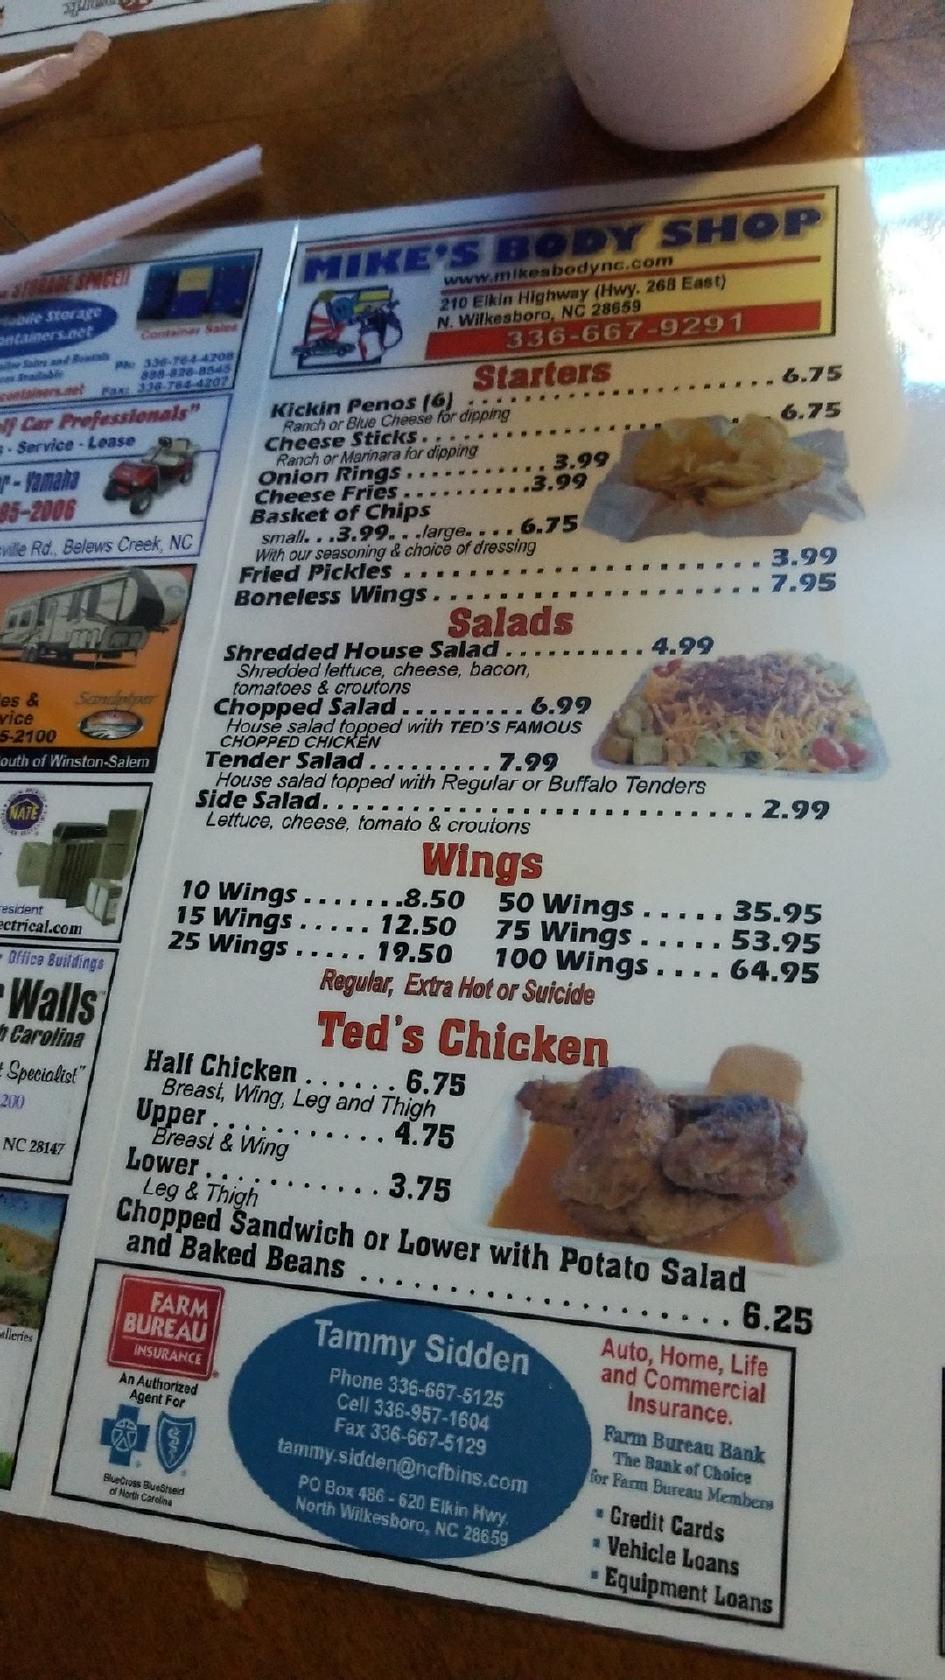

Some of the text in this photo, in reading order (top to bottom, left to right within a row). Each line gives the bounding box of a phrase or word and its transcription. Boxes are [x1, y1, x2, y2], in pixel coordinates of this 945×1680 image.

[304, 207, 822, 284] MIKE'S BODY SHOP
[443, 255, 674, 286] www.mikesbodync.com
[439, 274, 727, 312] 210 Elkin Highway (Hwy. 268 East)
[437, 300, 642, 330] N. Wilkesboro, NC 28659
[506, 312, 744, 350] 336-667-9291
[269, 364, 843, 419] Kickin Penos (6) 6.75
[472, 361, 612, 392] Starters
[20, 402, 201, 432] Car Professionals"
[264, 401, 842, 452] Cheese Sticks 6.75
[17, 435, 137, 455] Service Lease
[276, 443, 480, 467] Ranch or Marinara for dipping
[25, 468, 81, 494] Yamaha
[257, 451, 610, 487] Onion Rings 3.99
[250, 502, 432, 525] Basket of Chips
[261, 514, 579, 545] small 3.99 large 6.75
[63, 539, 115, 555] Belews
[117, 535, 164, 553] Creek,
[169, 533, 193, 551] NC
[234, 573, 838, 608] Boneless Wings 7.95
[447, 605, 575, 640] Salads
[223, 636, 715, 662] Shredded House Salad 4.99
[213, 695, 593, 721] Chopped Salad 6.99
[226, 717, 584, 738] House salad topped with TED'S FAMOUS
[37, 753, 151, 770] of Winston-Salem
[205, 751, 559, 773] Tender Salad 7.99
[9, 804, 40, 823] NATE
[205, 810, 532, 835] Lettuce, cheese, tomato & croutons
[422, 841, 544, 888] Wings
[182, 879, 466, 910] 10 Wings 8.50
[498, 891, 823, 925] 50 Wings 35.95
[8, 949, 105, 973] Office Buildings
[168, 930, 454, 964] 25 Wings 19.50
[495, 946, 820, 984] 100 Wings 64.95
[8, 977, 98, 1026] Walls
[319, 967, 596, 1006] Regular, Extra Hot or Suicide
[10, 1023, 87, 1049] Carolina
[317, 1010, 609, 1068] Ted's Chicken
[7, 1060, 87, 1085] Specialist"
[143, 1048, 467, 1097] Half Chicken 6.75
[161, 1077, 437, 1123] Breast, Wing, Leg and Thigh
[3, 1137, 67, 1157] NC 28147
[125, 1146, 452, 1203] Lower 3.75
[115, 1196, 747, 1294] Chopped Sandwich or Lower with Potato Salad
[126, 1231, 814, 1336] and Baked Beans 6.25
[150, 1291, 209, 1320] FARM
[122, 1311, 209, 1345] BUREAU
[133, 1343, 202, 1366] INSURANCE
[314, 1318, 531, 1376] Tammy Sidden
[600, 1337, 770, 1378] Auto, Home, Life
[118, 1371, 200, 1397] An Authorized
[129, 1389, 187, 1409] Agent For
[329, 1367, 505, 1410] Phone 336-667-5125
[600, 1365, 767, 1405] and Commercial
[336, 1392, 490, 1432] Cell 336-957-1604
[626, 1390, 734, 1426] Insurance.
[277, 1436, 530, 1494] tammy.sidden@ncfbins.com
[295, 1495, 510, 1548] North Wilkesboro, NC 28659
[610, 1504, 726, 1544] Credit Cards
[603, 1565, 774, 1616] Equipment Loans
